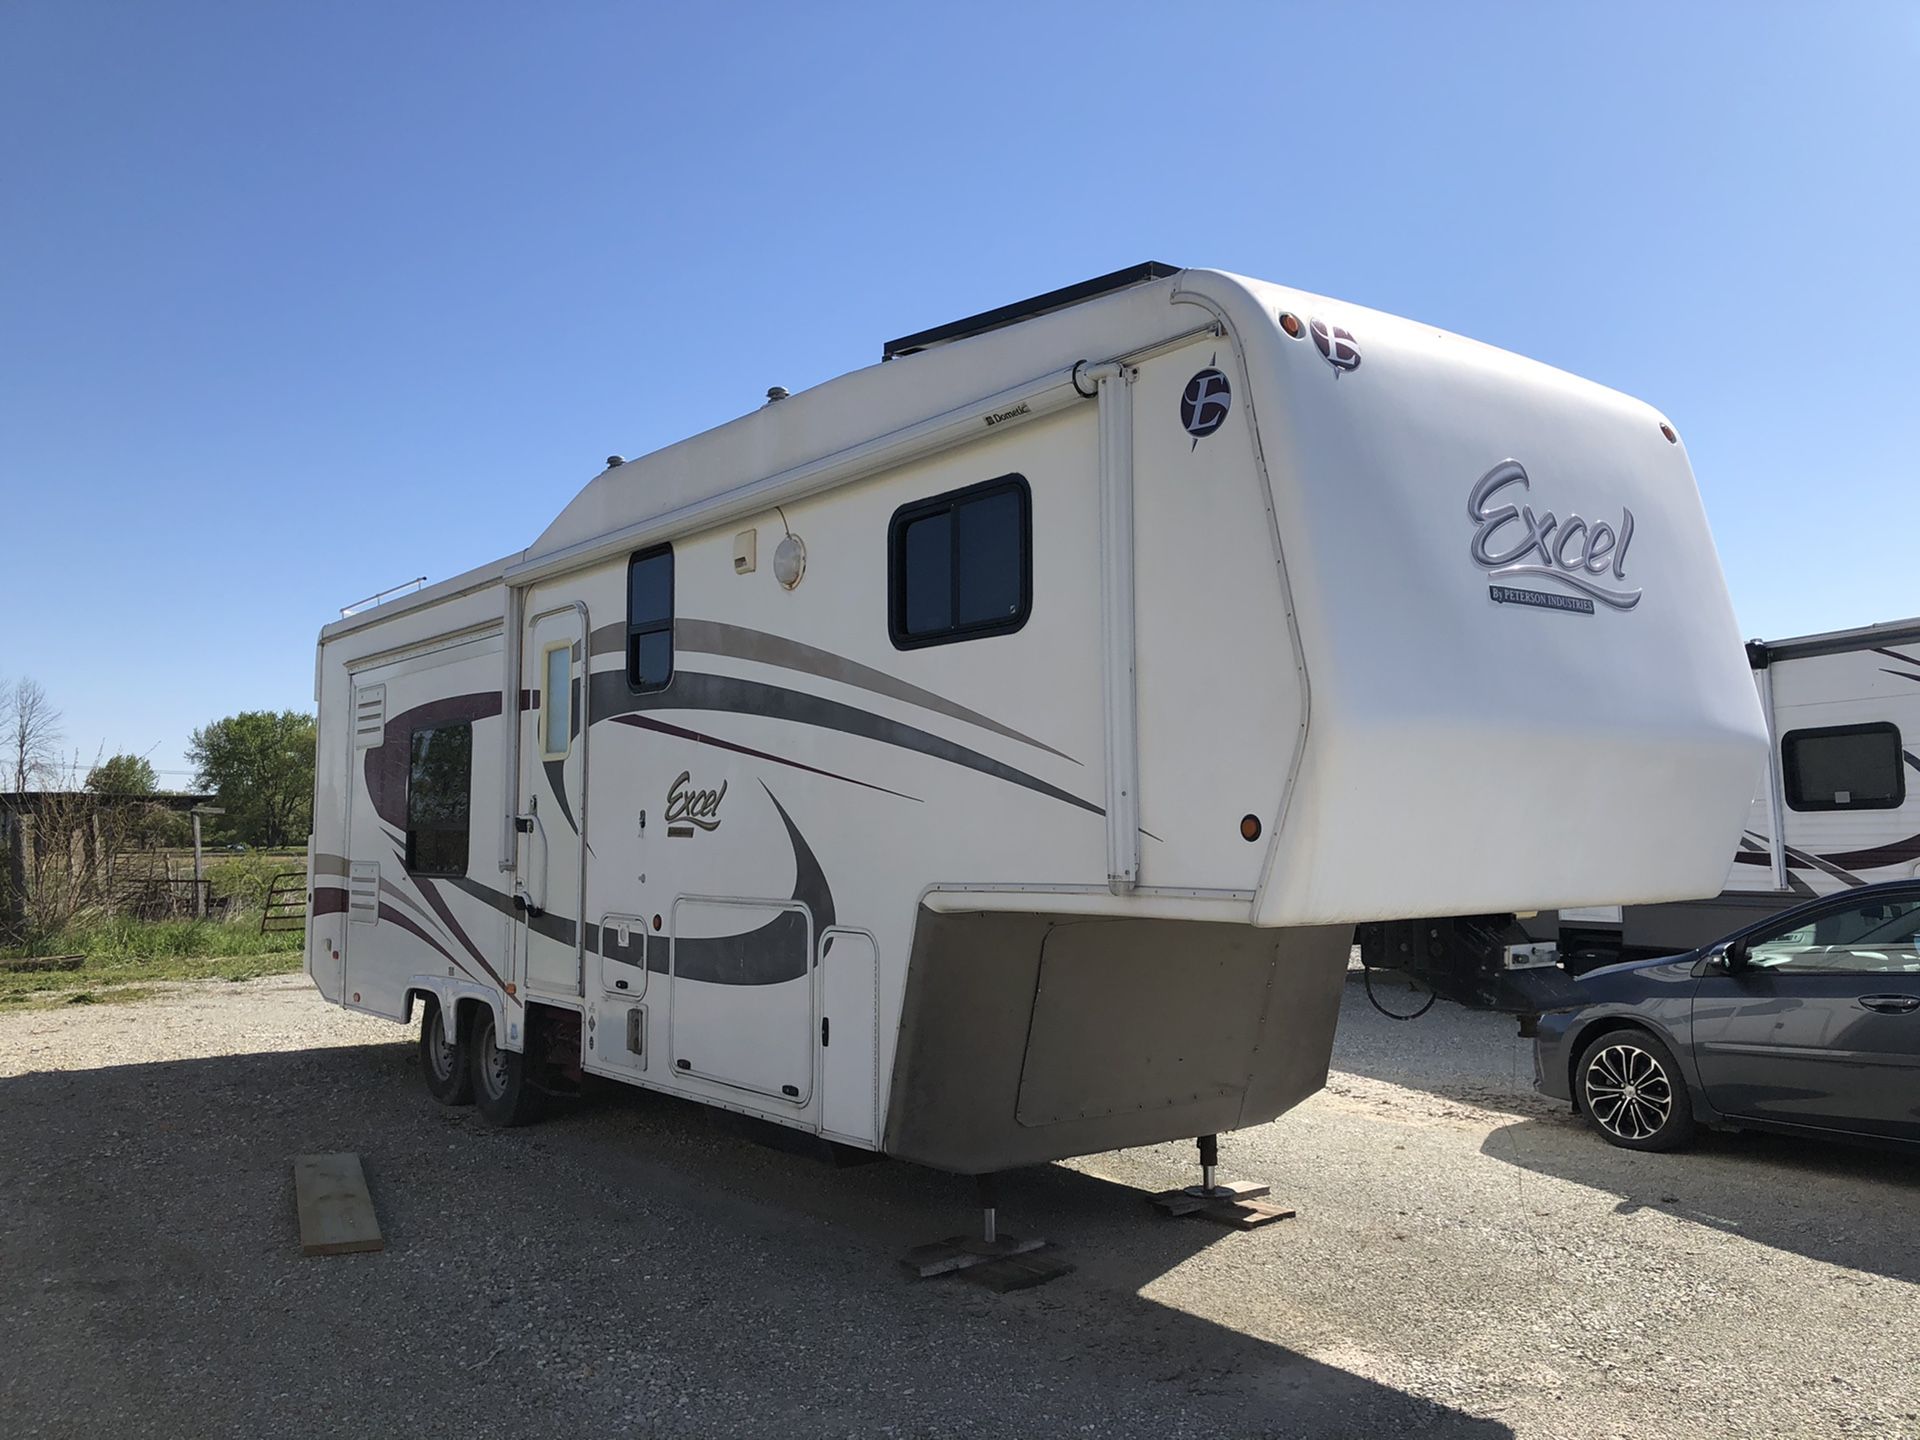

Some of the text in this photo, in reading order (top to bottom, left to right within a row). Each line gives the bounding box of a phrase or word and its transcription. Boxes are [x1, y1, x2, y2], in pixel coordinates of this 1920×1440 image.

[993, 404, 1028, 422] Dometic
[1468, 458, 1634, 579] Excel
[1492, 588, 1593, 611] By PETERSON INDUSTRIES
[664, 770, 728, 821] Excel
